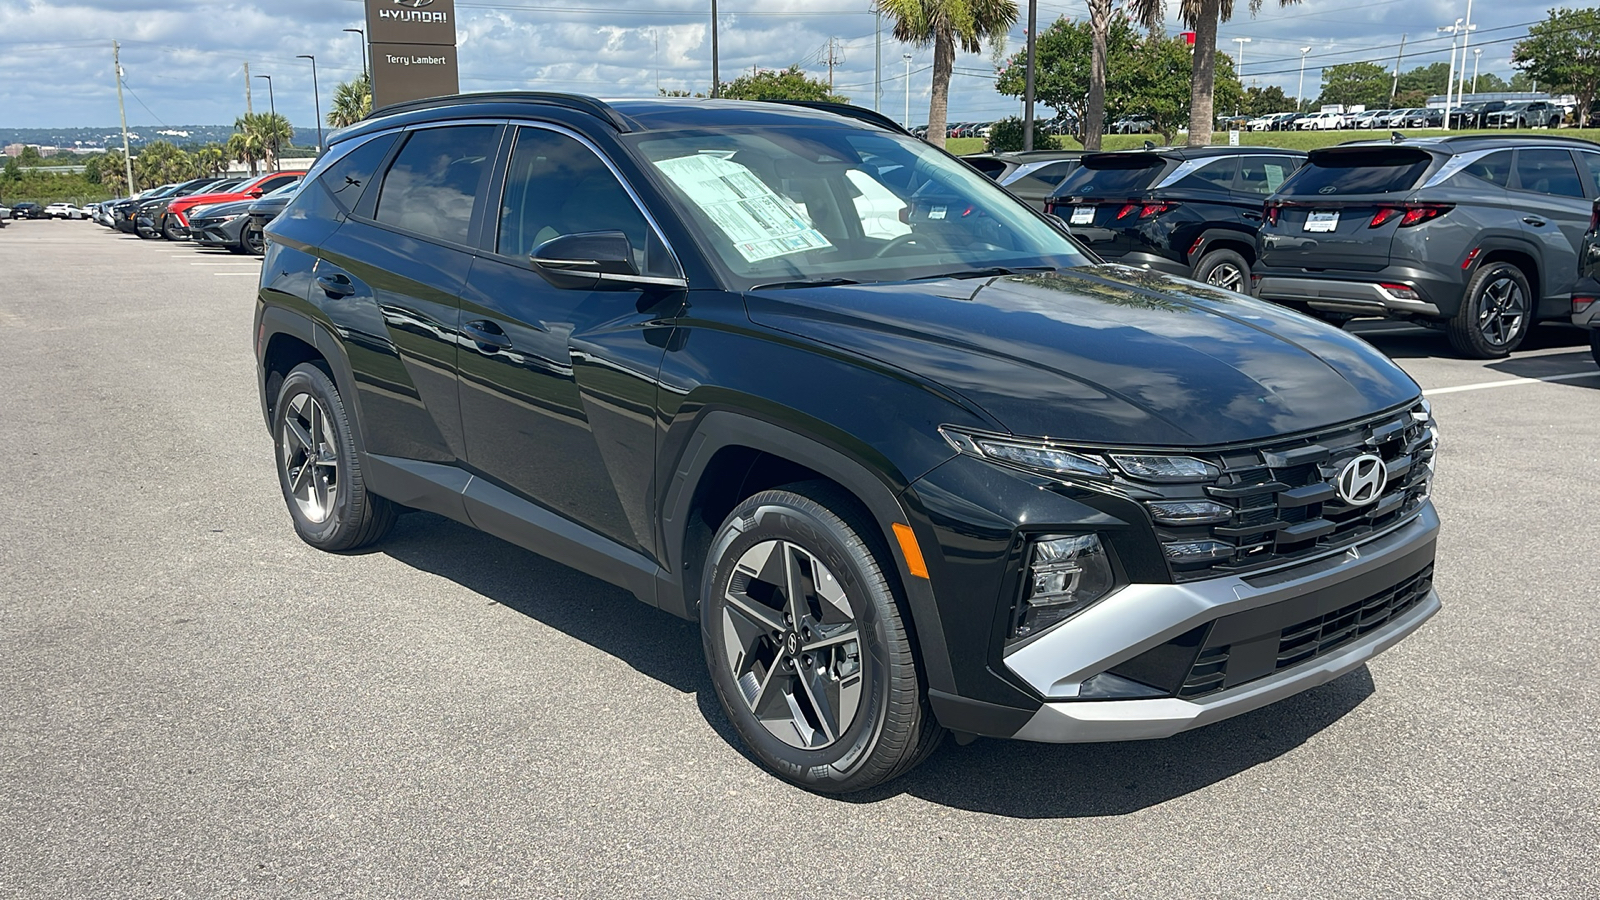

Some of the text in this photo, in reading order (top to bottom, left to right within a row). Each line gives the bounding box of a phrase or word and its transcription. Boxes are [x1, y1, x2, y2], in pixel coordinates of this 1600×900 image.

[379, 9, 447, 23] HYUNDAI
[386, 54, 446, 65] Terry Lambert
